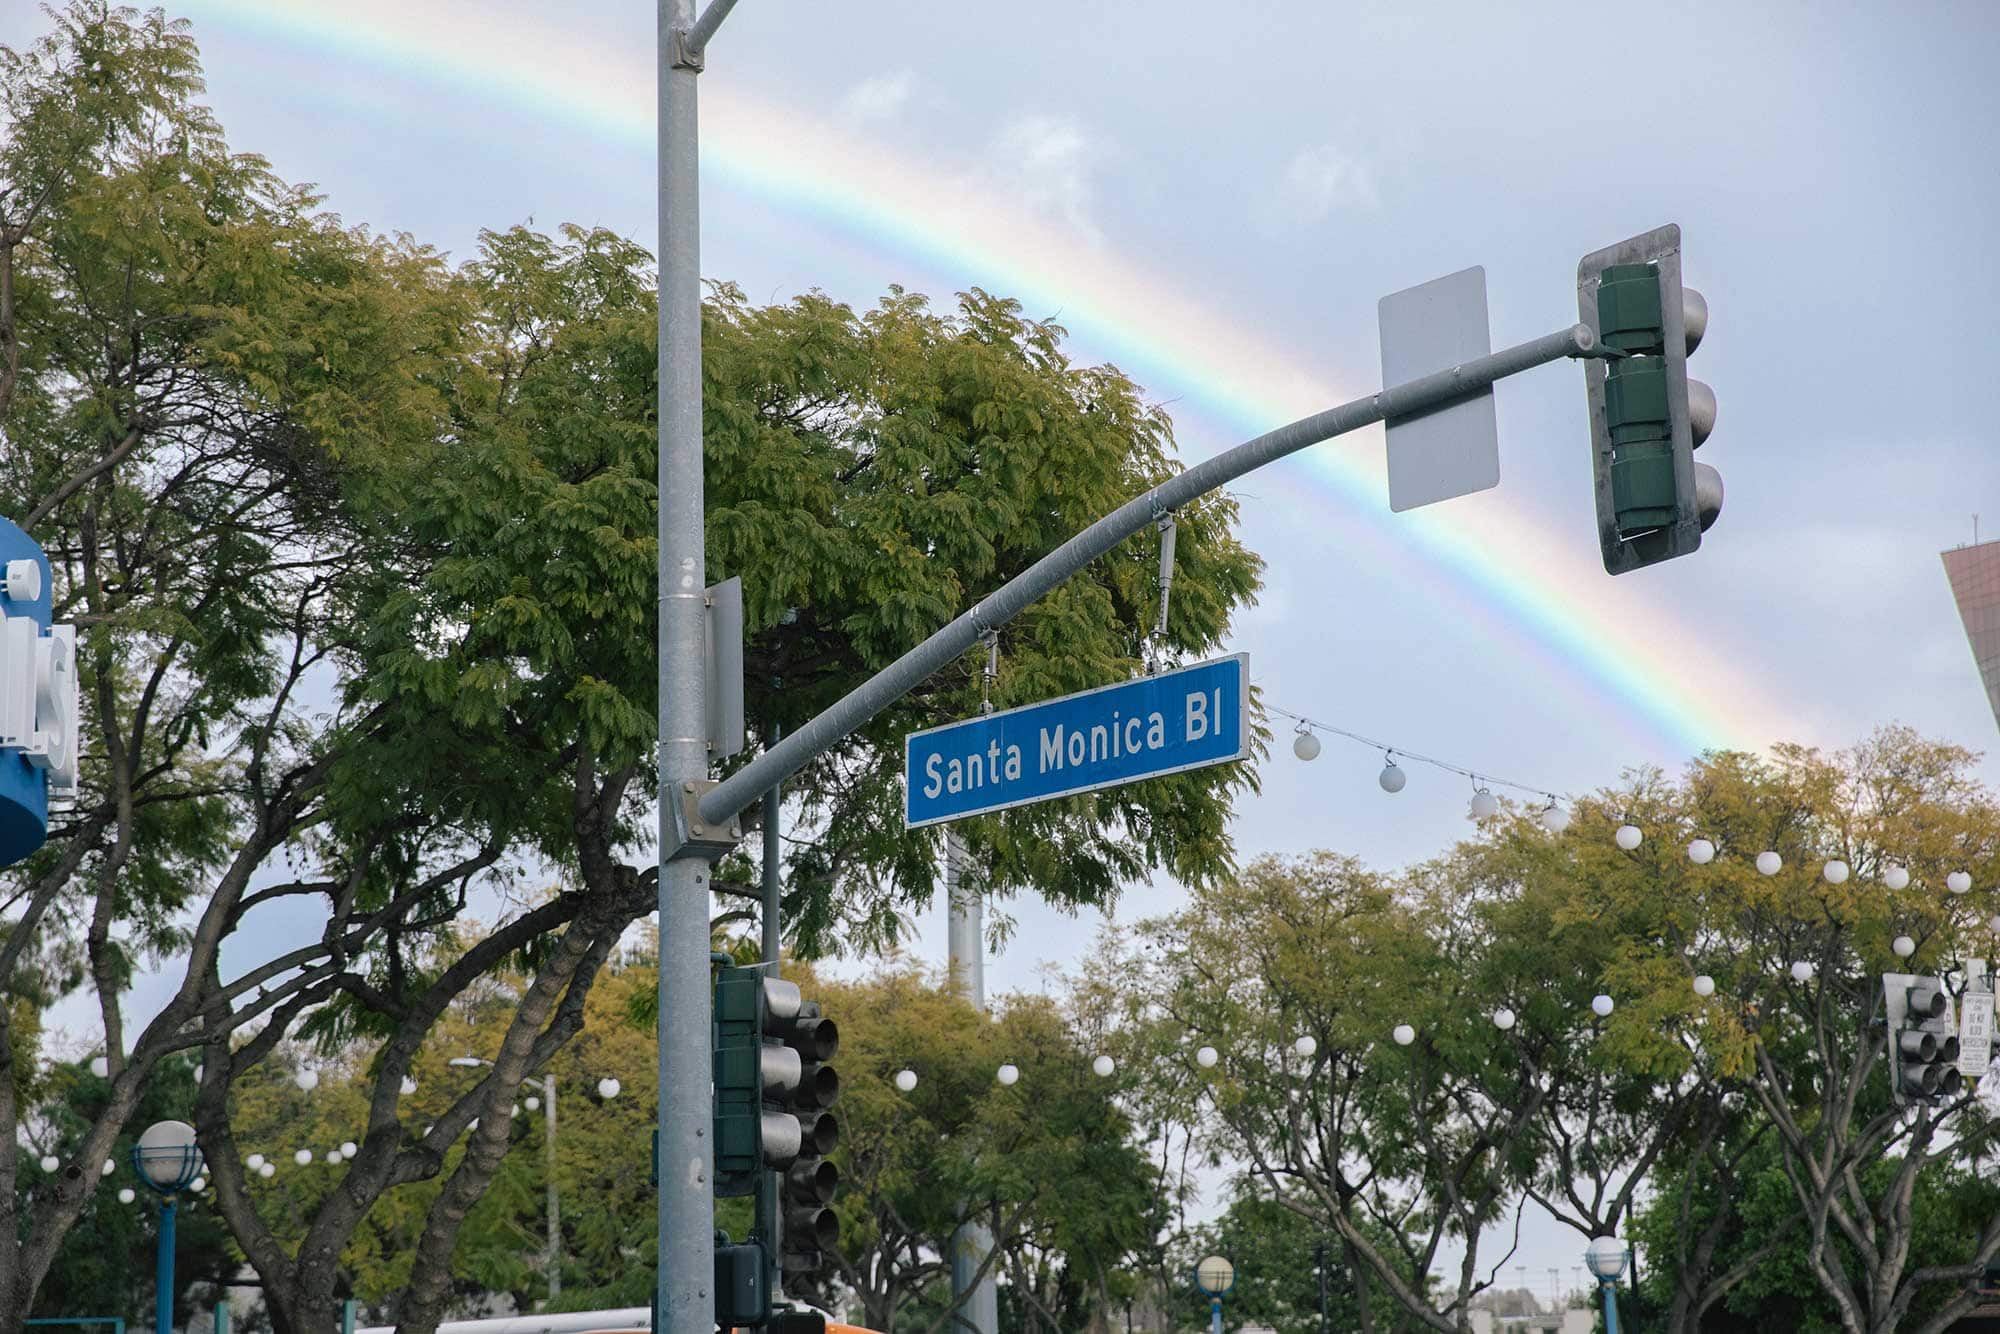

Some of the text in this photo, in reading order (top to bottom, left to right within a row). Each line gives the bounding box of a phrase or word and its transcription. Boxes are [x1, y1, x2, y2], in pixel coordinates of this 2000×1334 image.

[923, 687, 1221, 799] Santa Monica Bl
